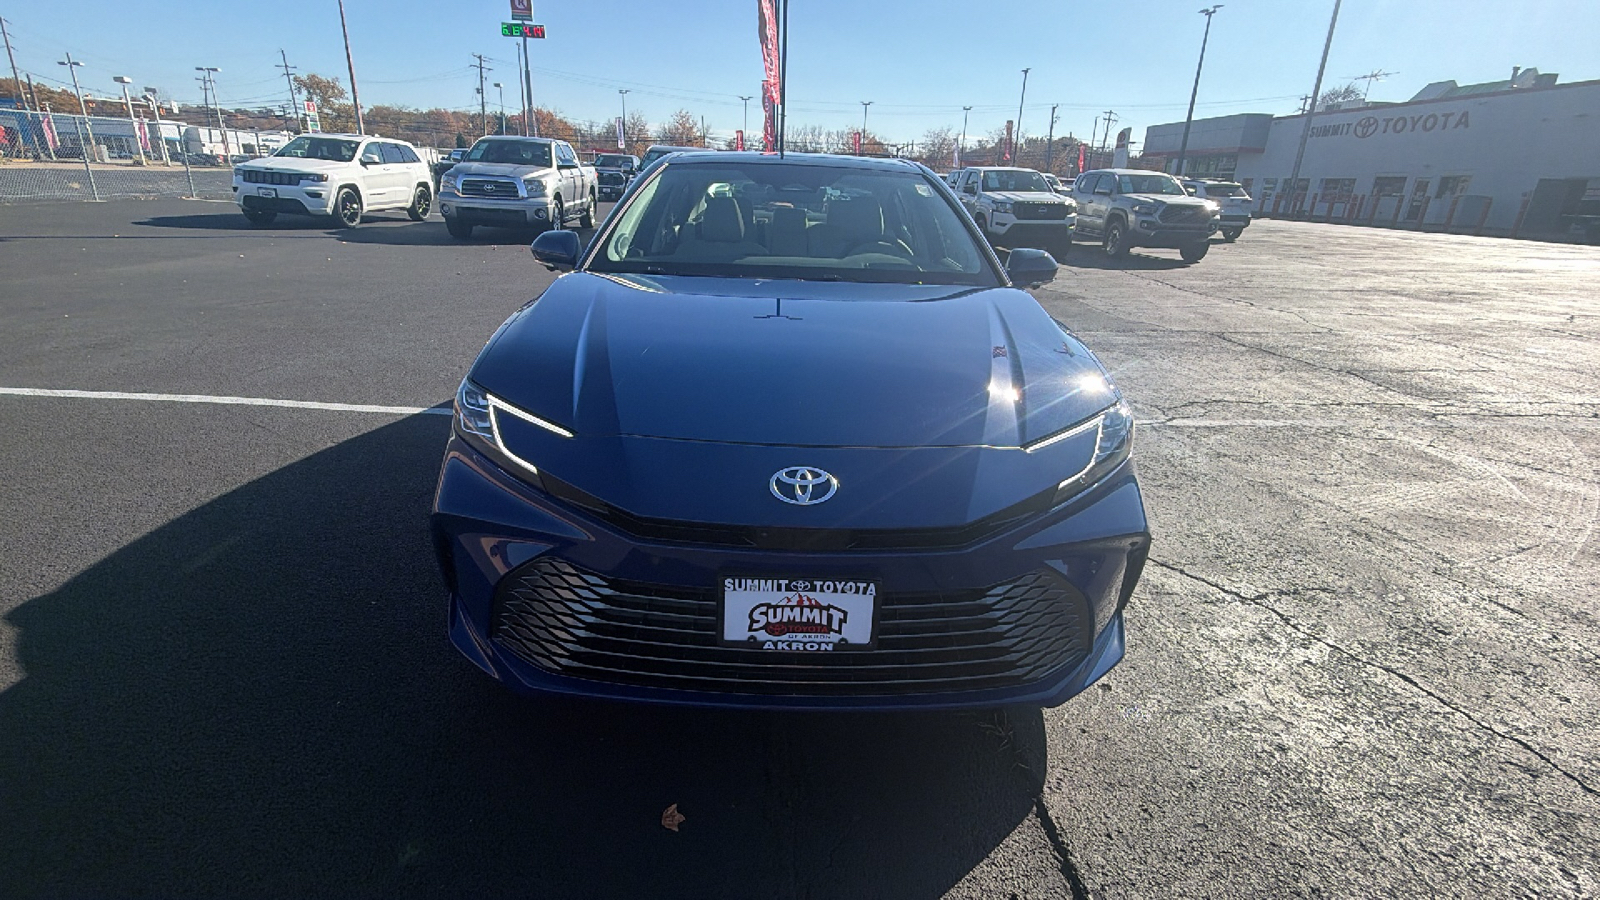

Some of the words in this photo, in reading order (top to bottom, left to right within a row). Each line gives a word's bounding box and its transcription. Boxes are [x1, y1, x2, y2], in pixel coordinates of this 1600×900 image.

[1309, 122, 1352, 138] SUMMIT
[1381, 110, 1470, 134] TOYOTA
[724, 578, 789, 592] SUMMIT
[813, 580, 877, 596] TOYOTA
[751, 605, 844, 632] SUMMIT
[788, 625, 829, 633] TOYOTA
[763, 641, 834, 651] AKRON
